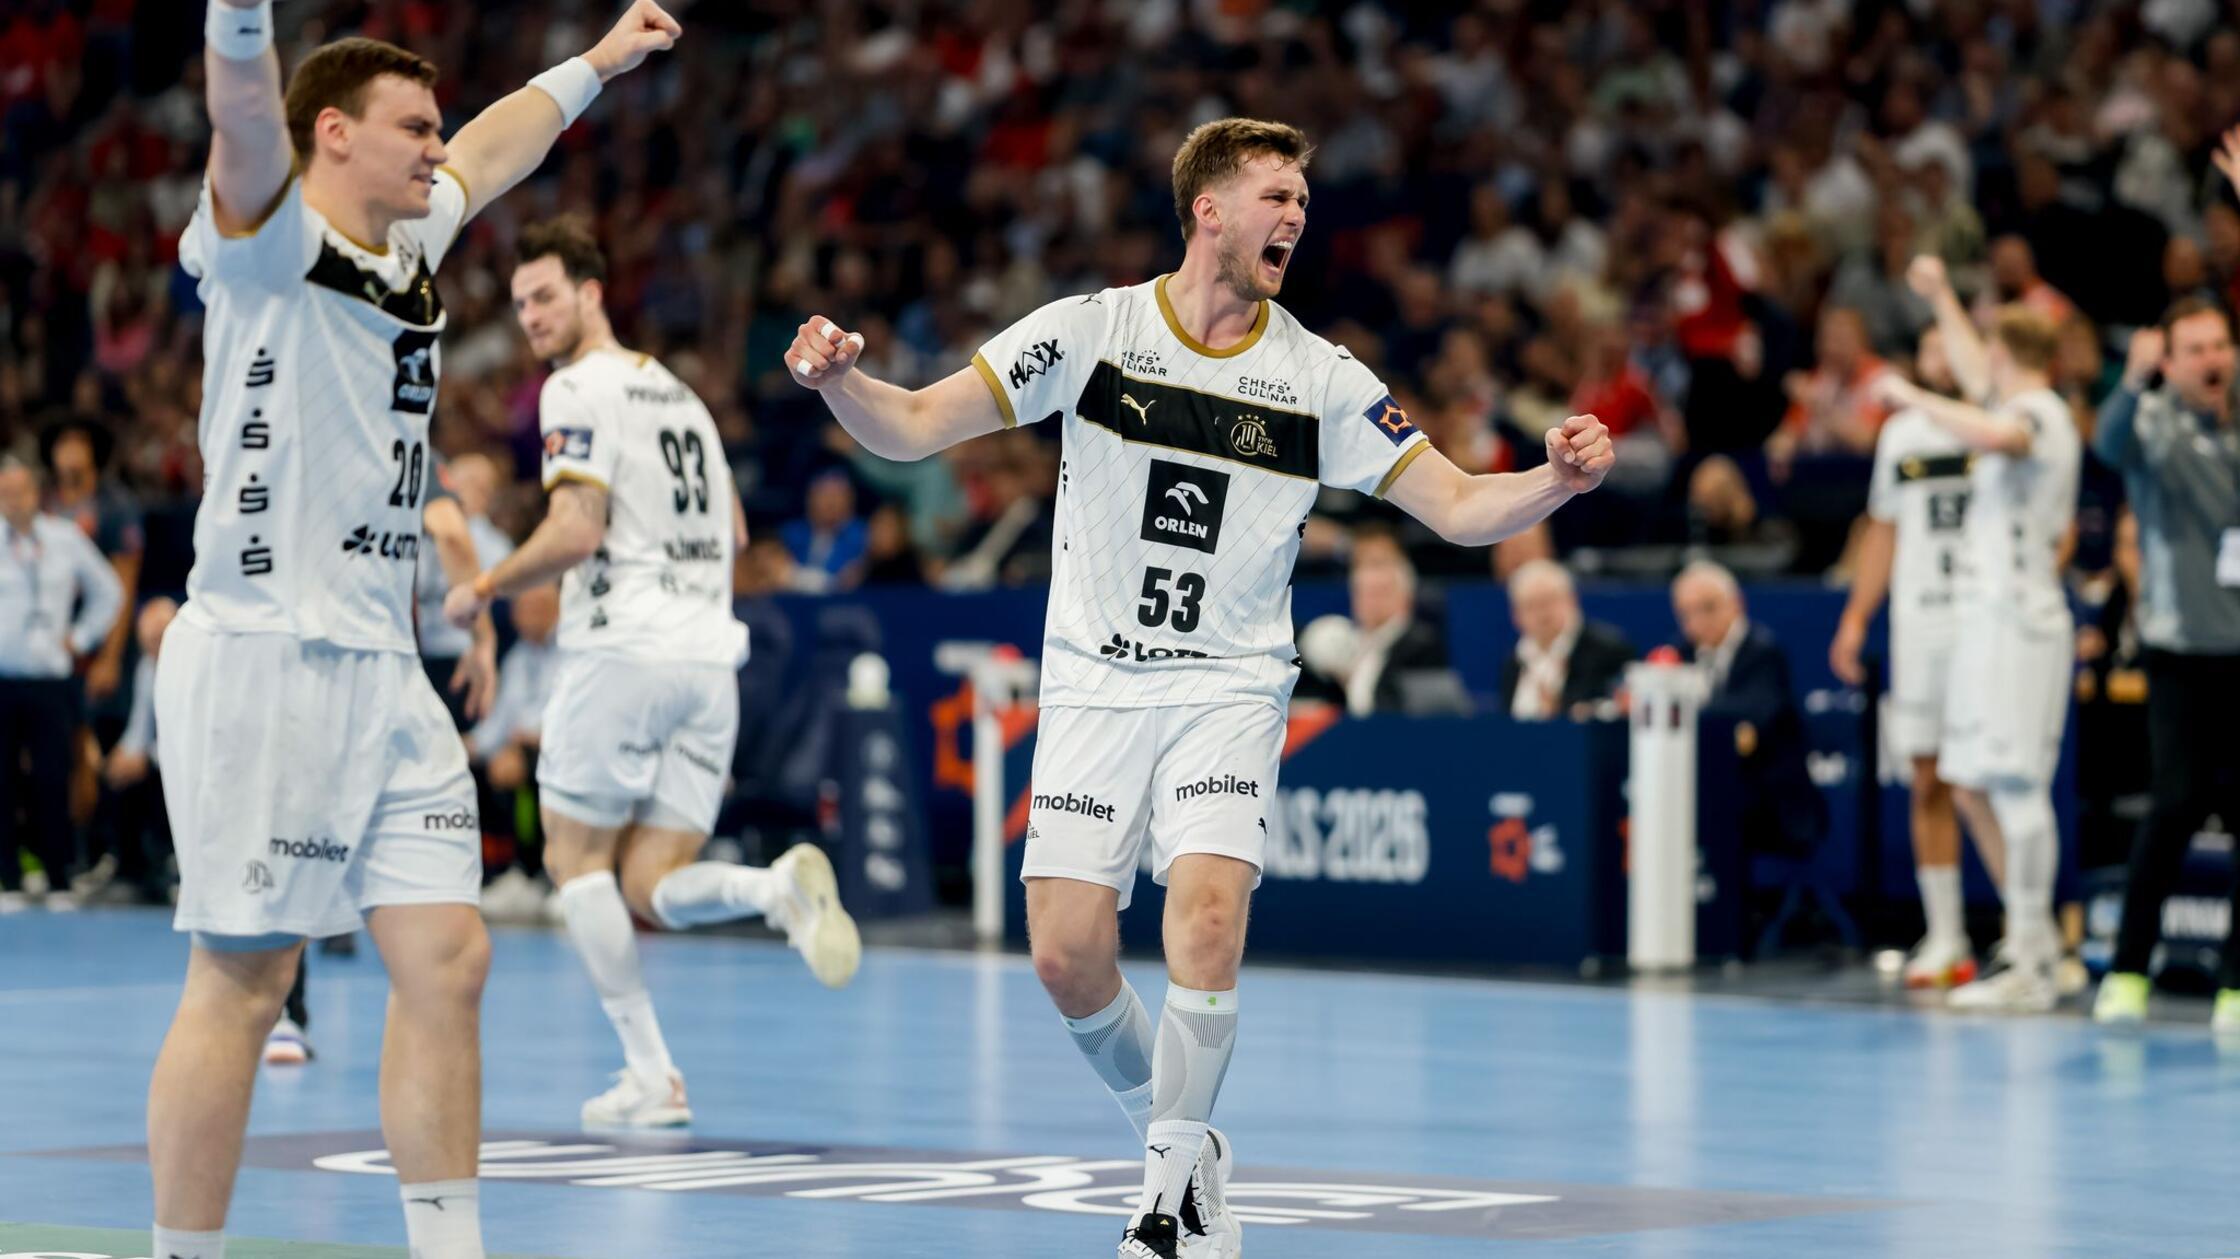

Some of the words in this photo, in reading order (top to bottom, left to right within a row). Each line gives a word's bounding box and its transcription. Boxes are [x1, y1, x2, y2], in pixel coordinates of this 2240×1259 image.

[1120, 359, 1168, 377] LINAR
[1121, 350, 1154, 366] HEFS
[1237, 385, 1298, 405] CULINAR
[1239, 376, 1285, 395] CHEFS
[1256, 441, 1278, 457] KIEL
[388, 439, 423, 509] 20
[658, 428, 709, 515] 93
[1154, 515, 1209, 539] ORLEN
[1137, 565, 1207, 634] 53
[1134, 641, 1219, 663] LOTT
[1176, 774, 1260, 802] mobilet
[424, 807, 478, 831] mob
[1032, 792, 1116, 823] mobilet
[269, 836, 349, 863] mobilet
